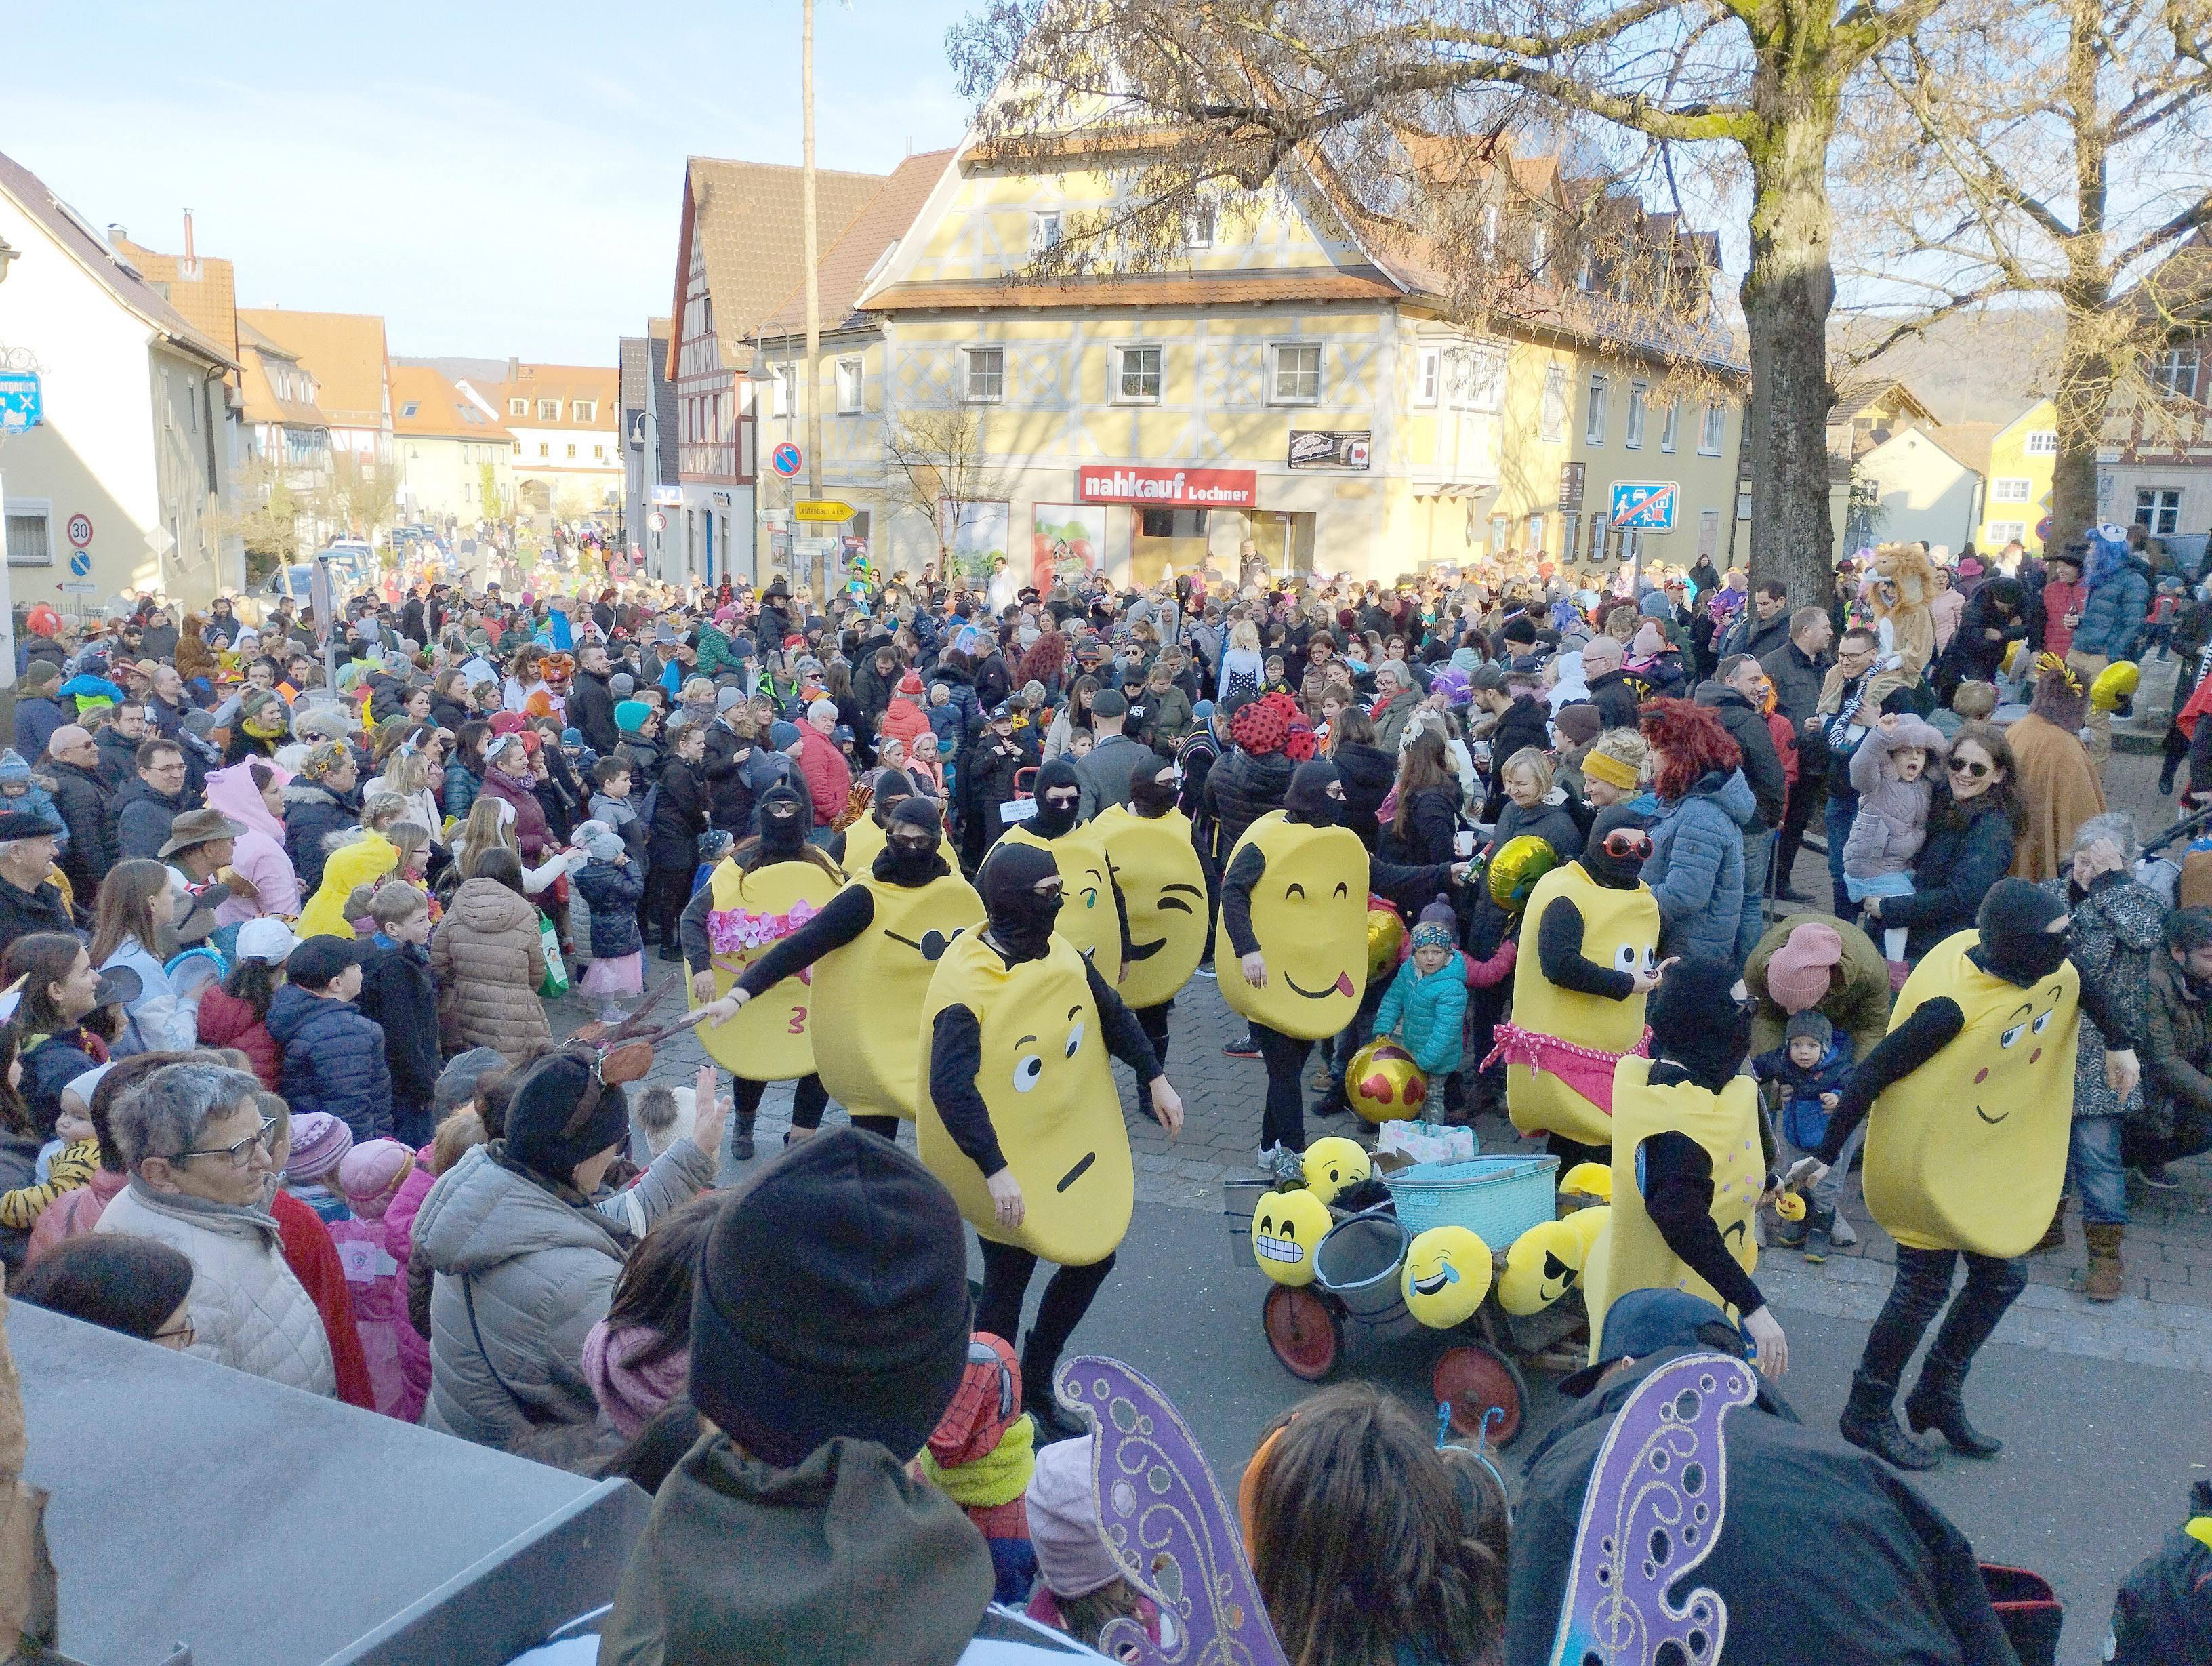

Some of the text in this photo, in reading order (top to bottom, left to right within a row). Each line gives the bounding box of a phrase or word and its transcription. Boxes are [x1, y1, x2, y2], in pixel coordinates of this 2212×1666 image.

[1086, 471, 1249, 502] nahkauf Lochner
[798, 506, 830, 515] Leutenbach
[72, 523, 87, 539] 30
[994, 707, 1006, 716] SEK
[1130, 705, 1147, 718] SEK
